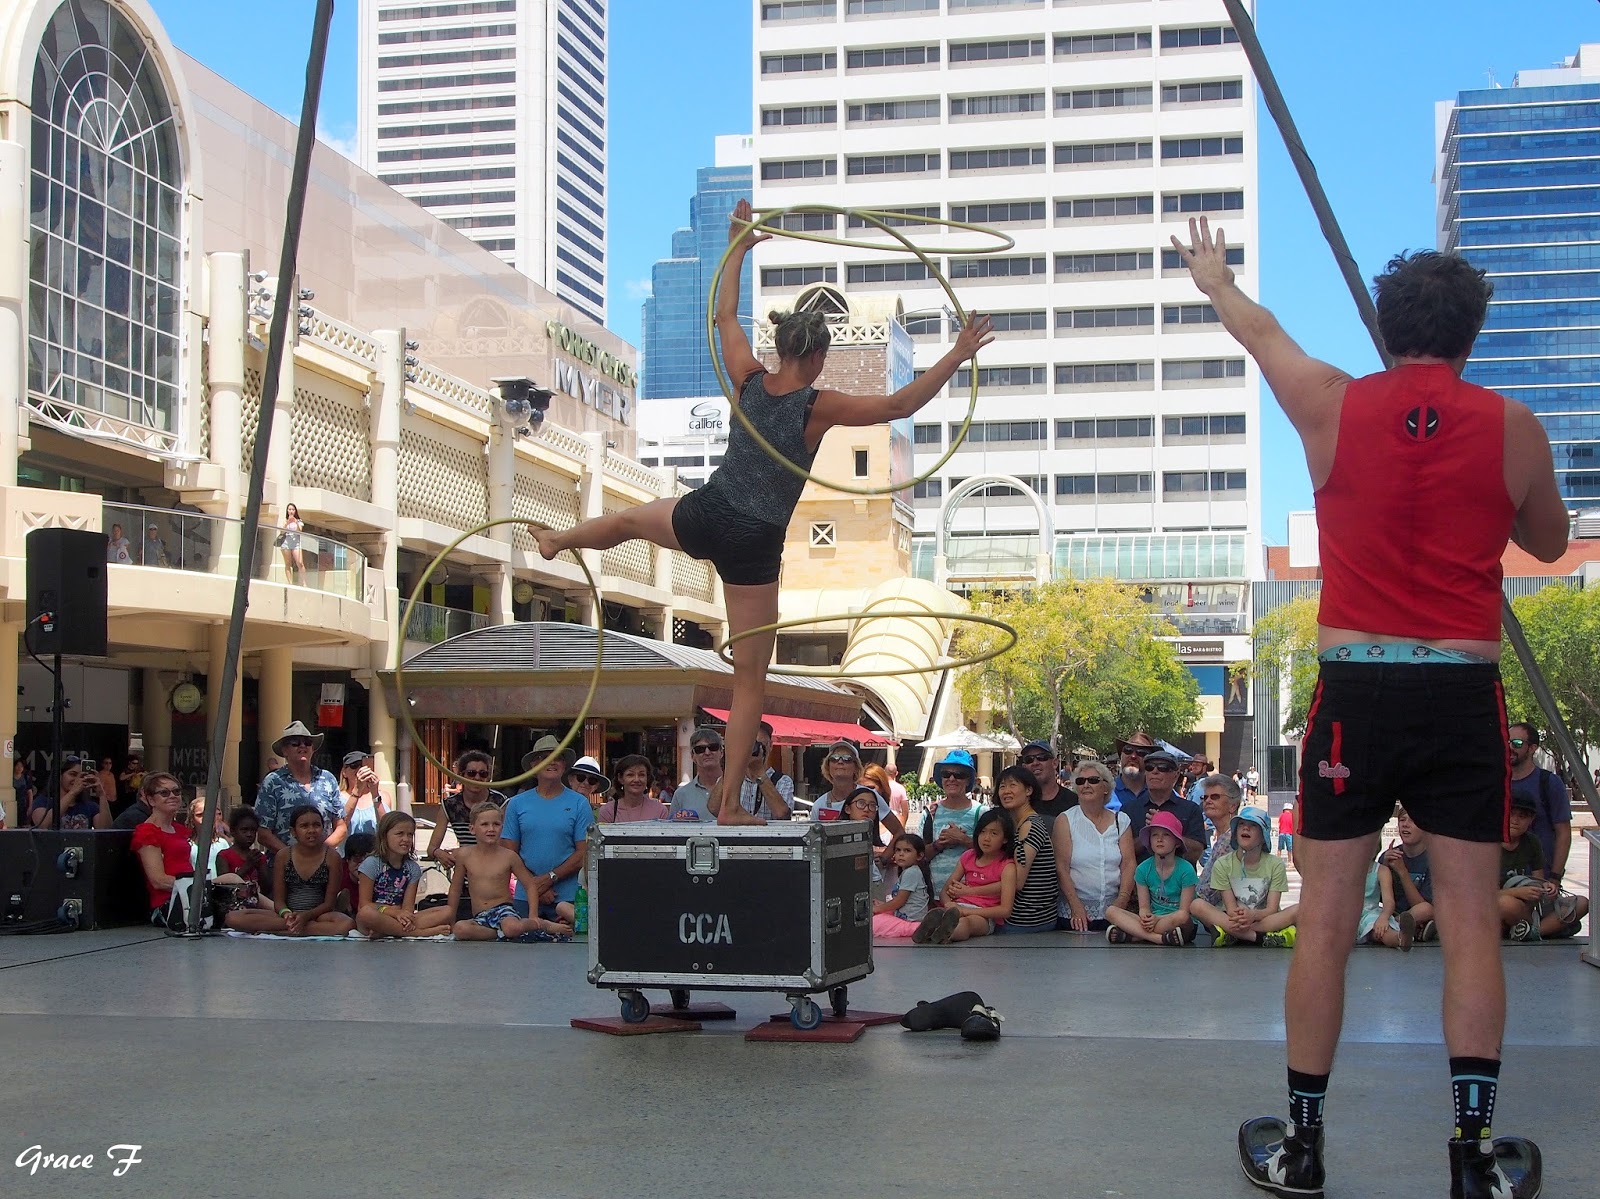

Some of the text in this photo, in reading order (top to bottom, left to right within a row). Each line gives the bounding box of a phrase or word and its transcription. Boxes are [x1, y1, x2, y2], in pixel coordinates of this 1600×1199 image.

[555, 358, 631, 427] MYER
[689, 417, 723, 430] calibre
[1175, 642, 1192, 654] llas
[173, 748, 208, 768] MYER
[679, 912, 733, 944] CCA
